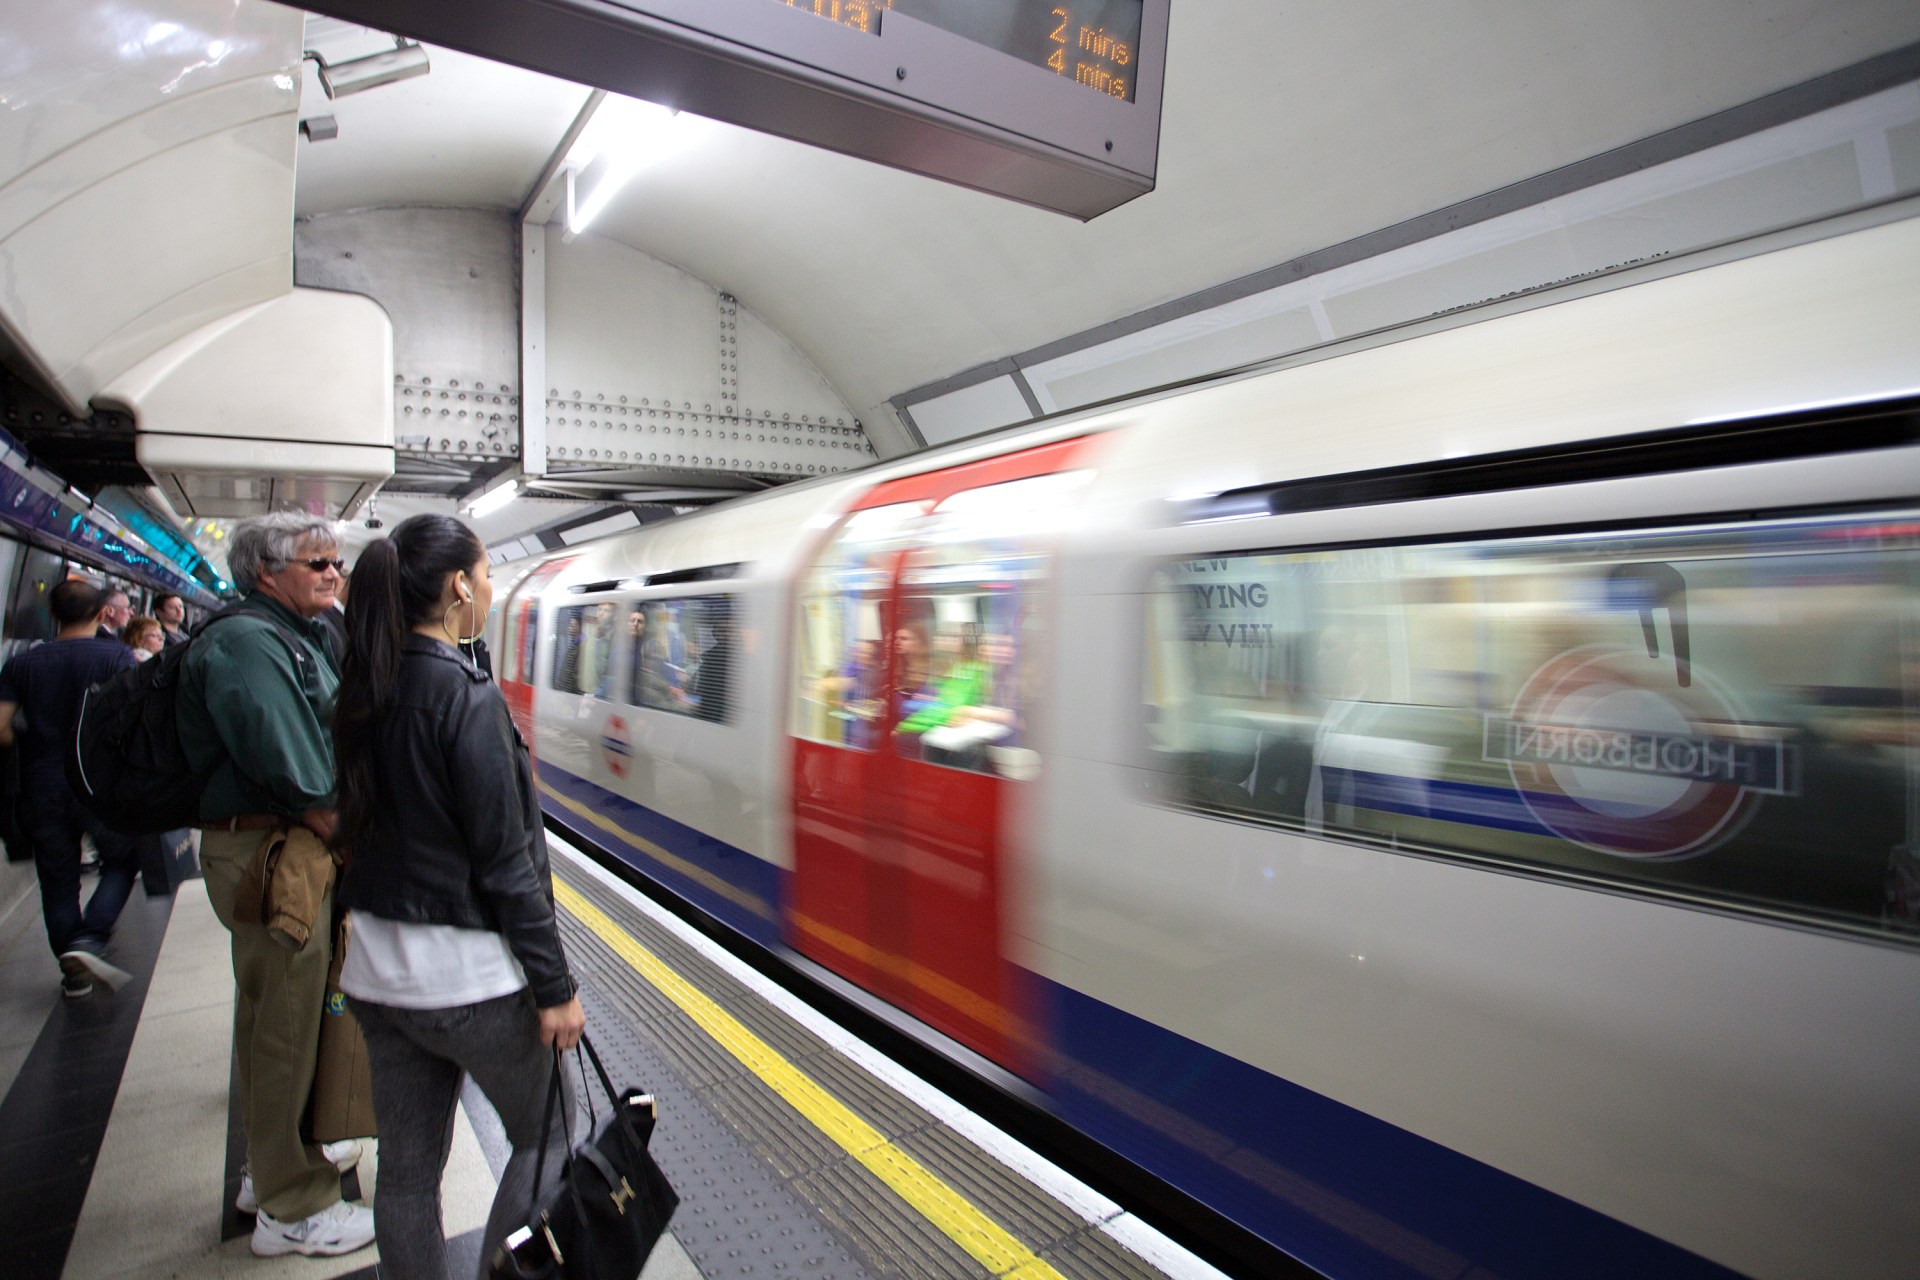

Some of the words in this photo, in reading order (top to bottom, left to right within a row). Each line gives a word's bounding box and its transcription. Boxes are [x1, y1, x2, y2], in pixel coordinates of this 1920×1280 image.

[1050, 8, 1068, 43] 2
[1079, 26, 1128, 65] mins
[1047, 48, 1063, 75] 4
[1076, 63, 1125, 99] mins
